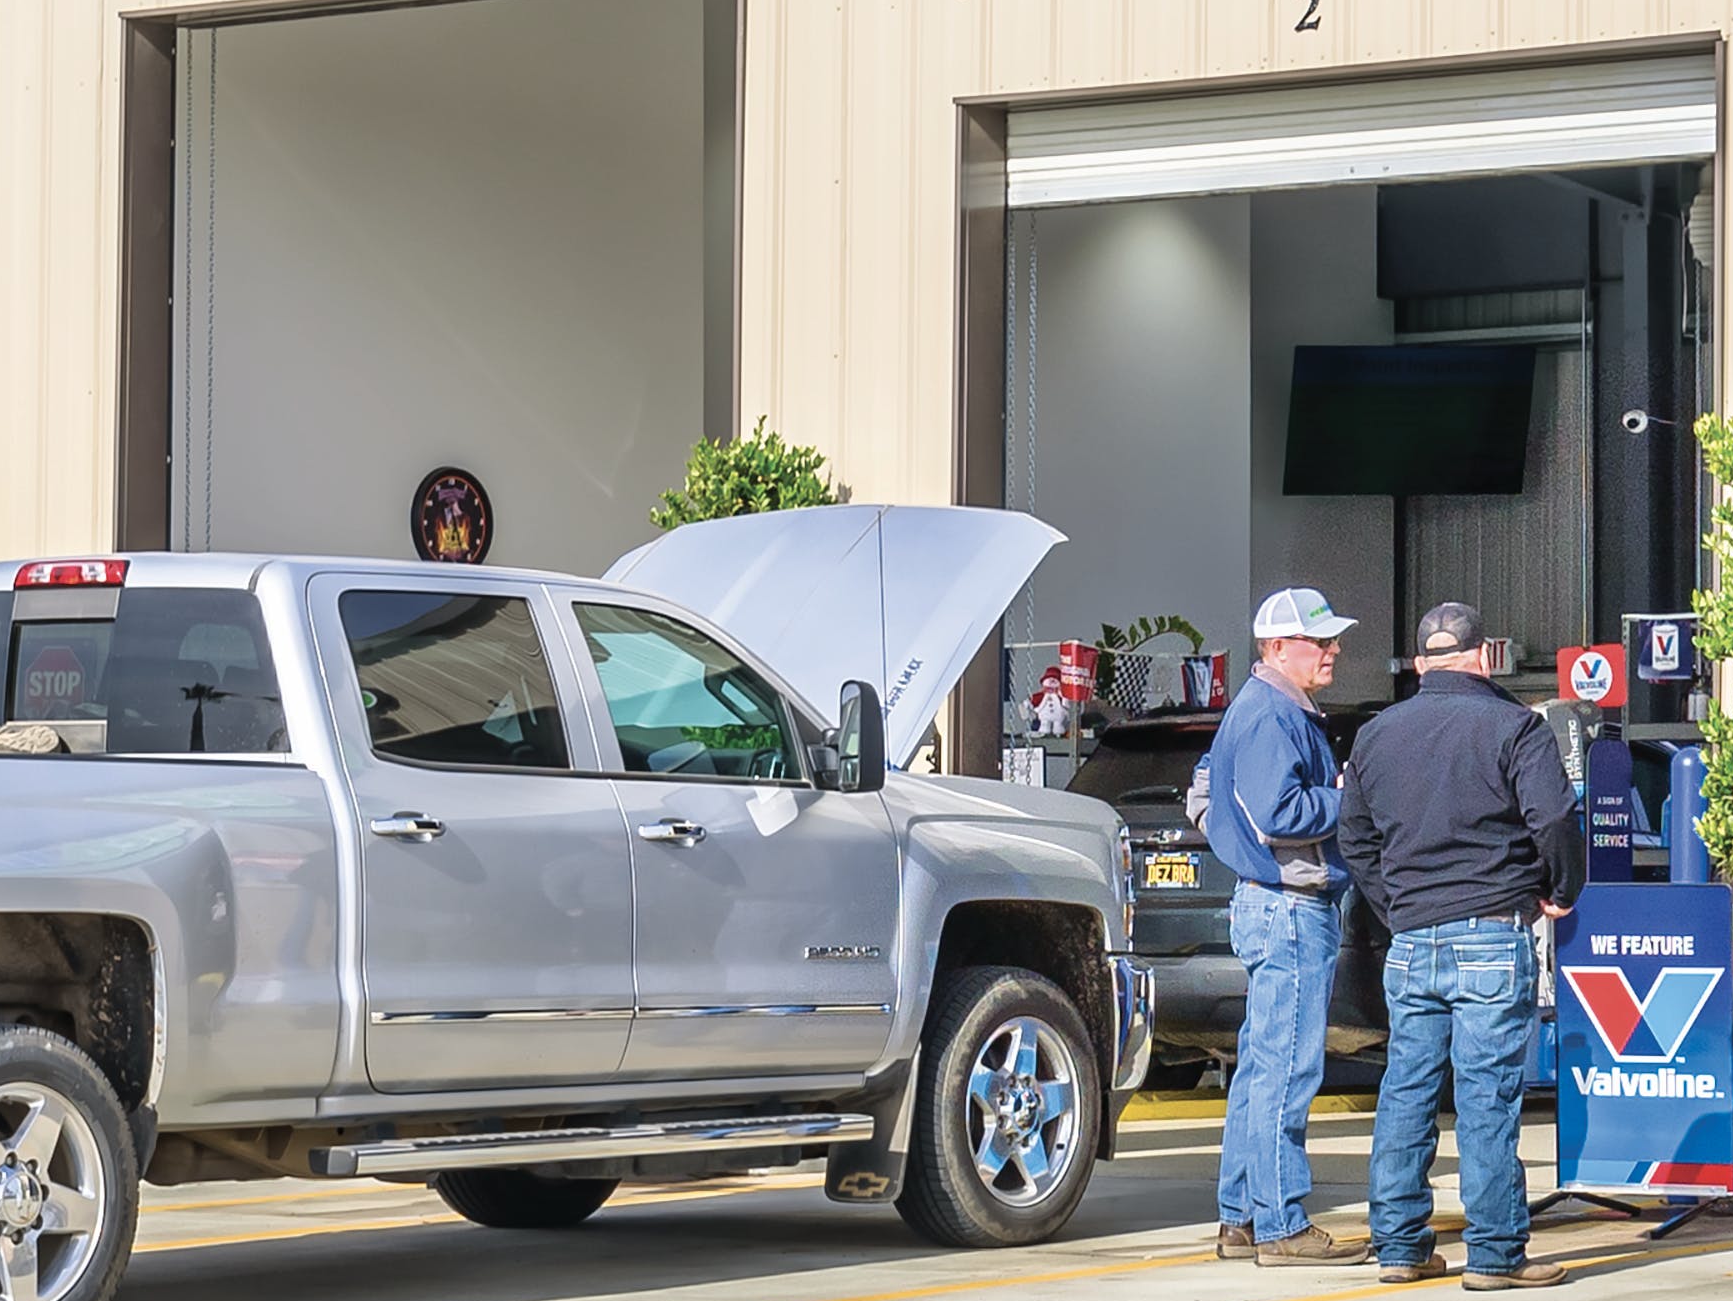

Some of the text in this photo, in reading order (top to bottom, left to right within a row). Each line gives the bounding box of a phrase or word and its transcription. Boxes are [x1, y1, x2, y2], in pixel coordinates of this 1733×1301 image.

[28, 670, 82, 697] STOP
[1592, 812, 1629, 826] QUALITY
[1593, 833, 1629, 848] SERVICE
[1590, 934, 1695, 957] WE FEATURE
[1570, 1066, 1716, 1099] Valvoline
